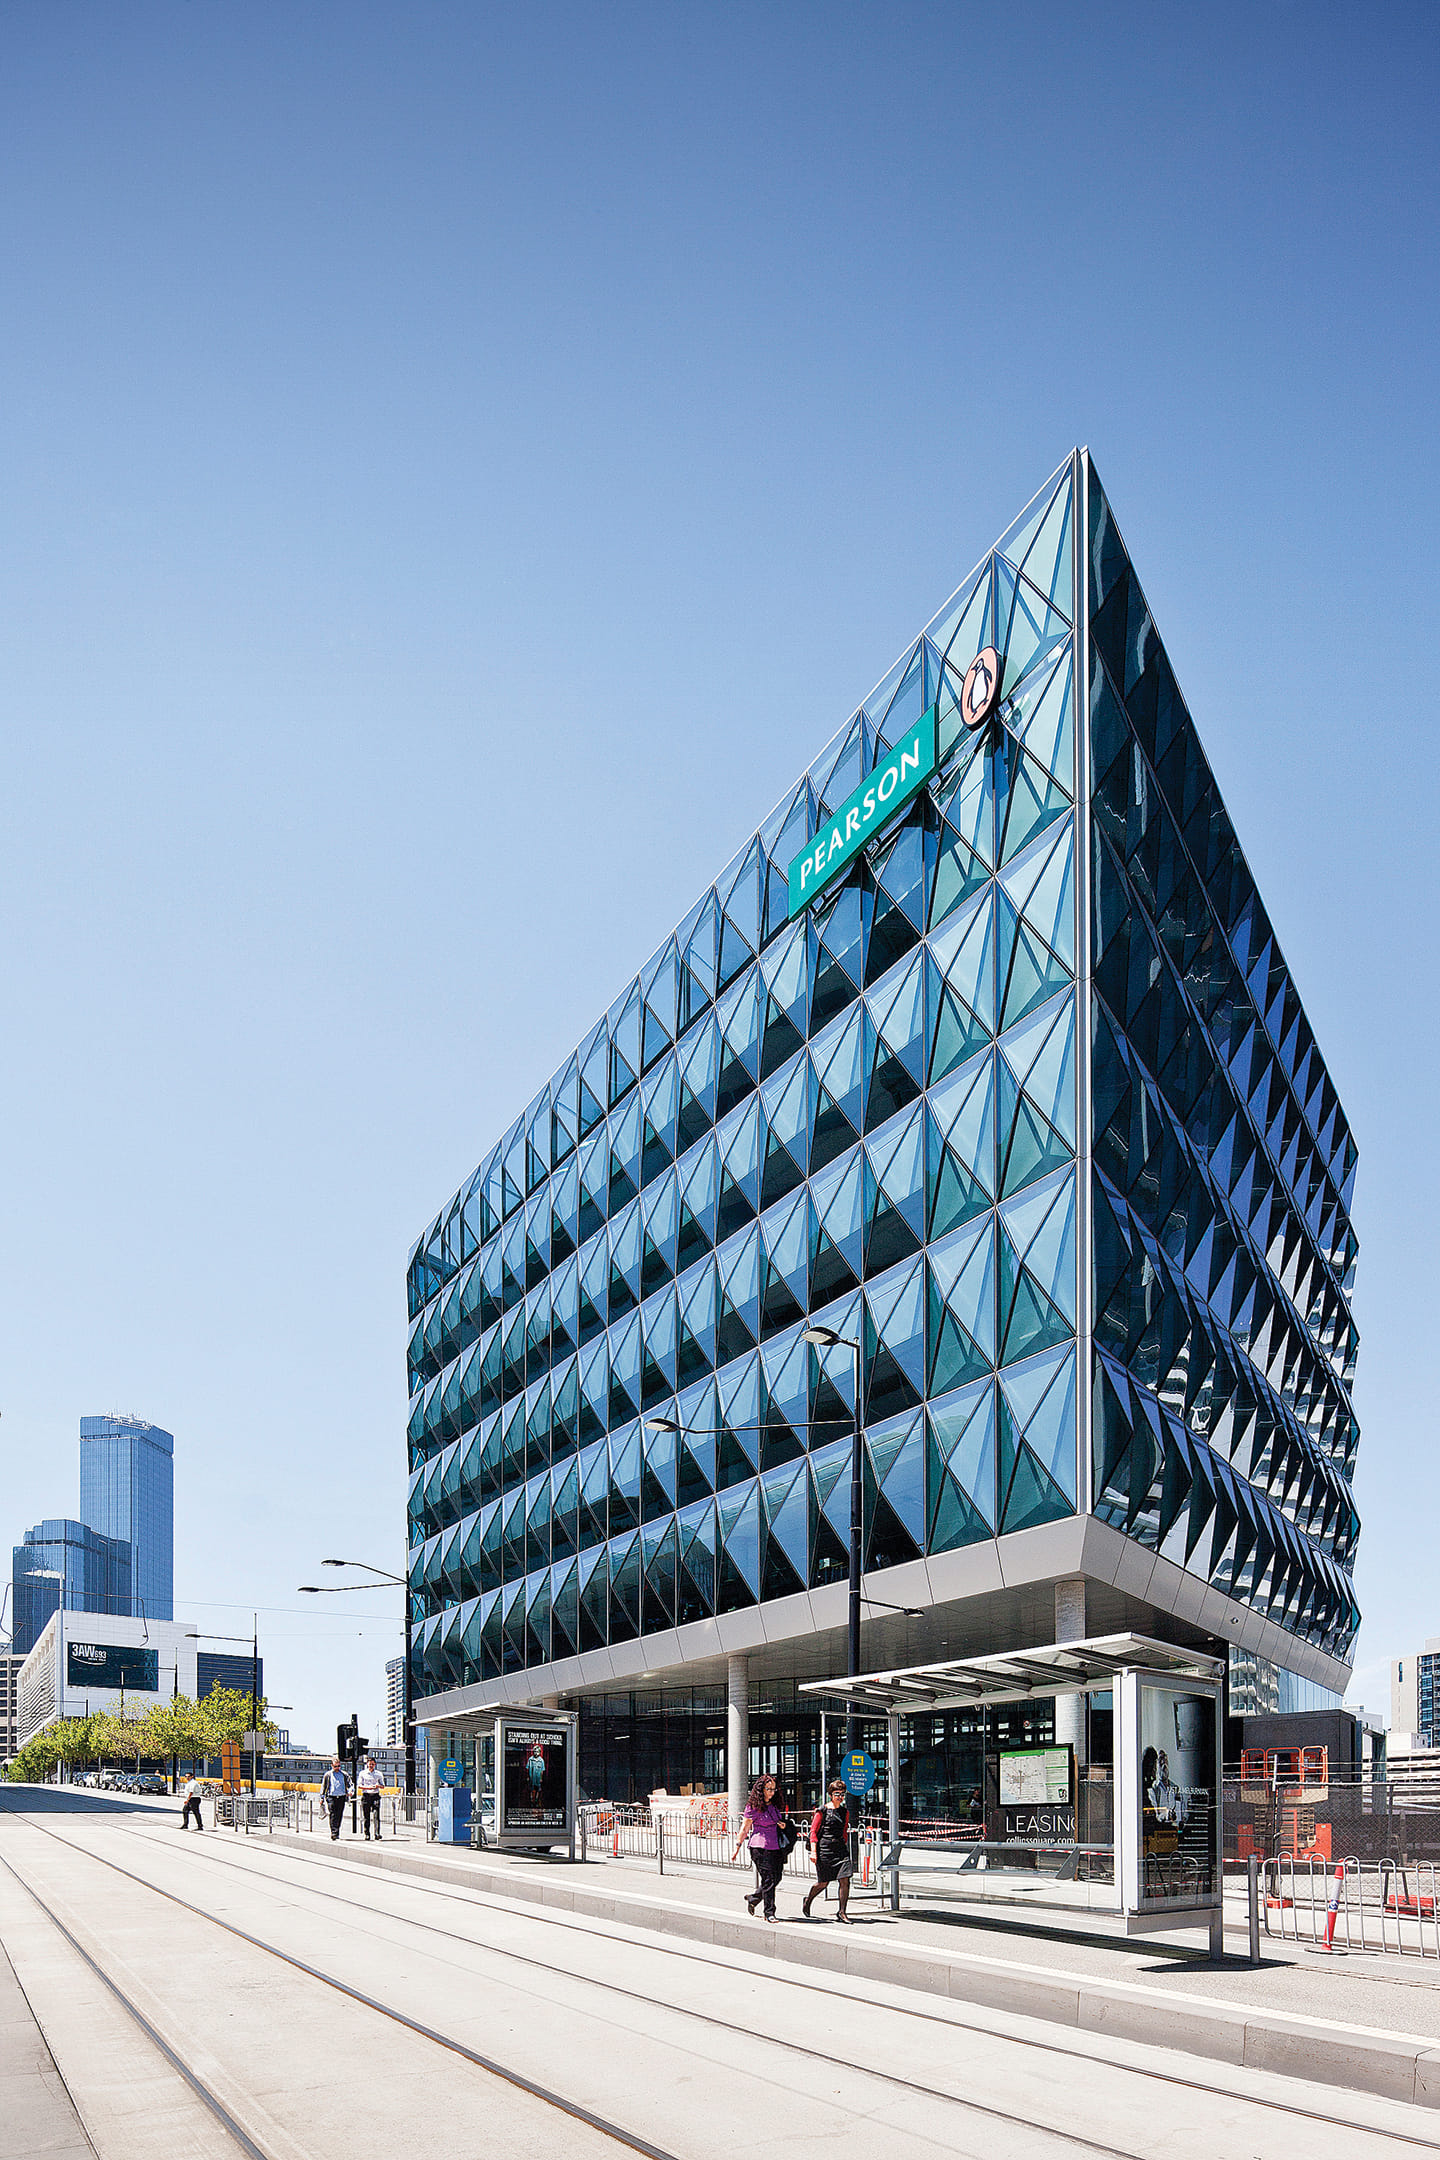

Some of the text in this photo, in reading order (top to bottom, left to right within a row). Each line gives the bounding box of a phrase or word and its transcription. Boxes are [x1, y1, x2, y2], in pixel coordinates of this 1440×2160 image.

[799, 737, 921, 891] PEARSON
[71, 1643, 107, 1659] 3AW 693
